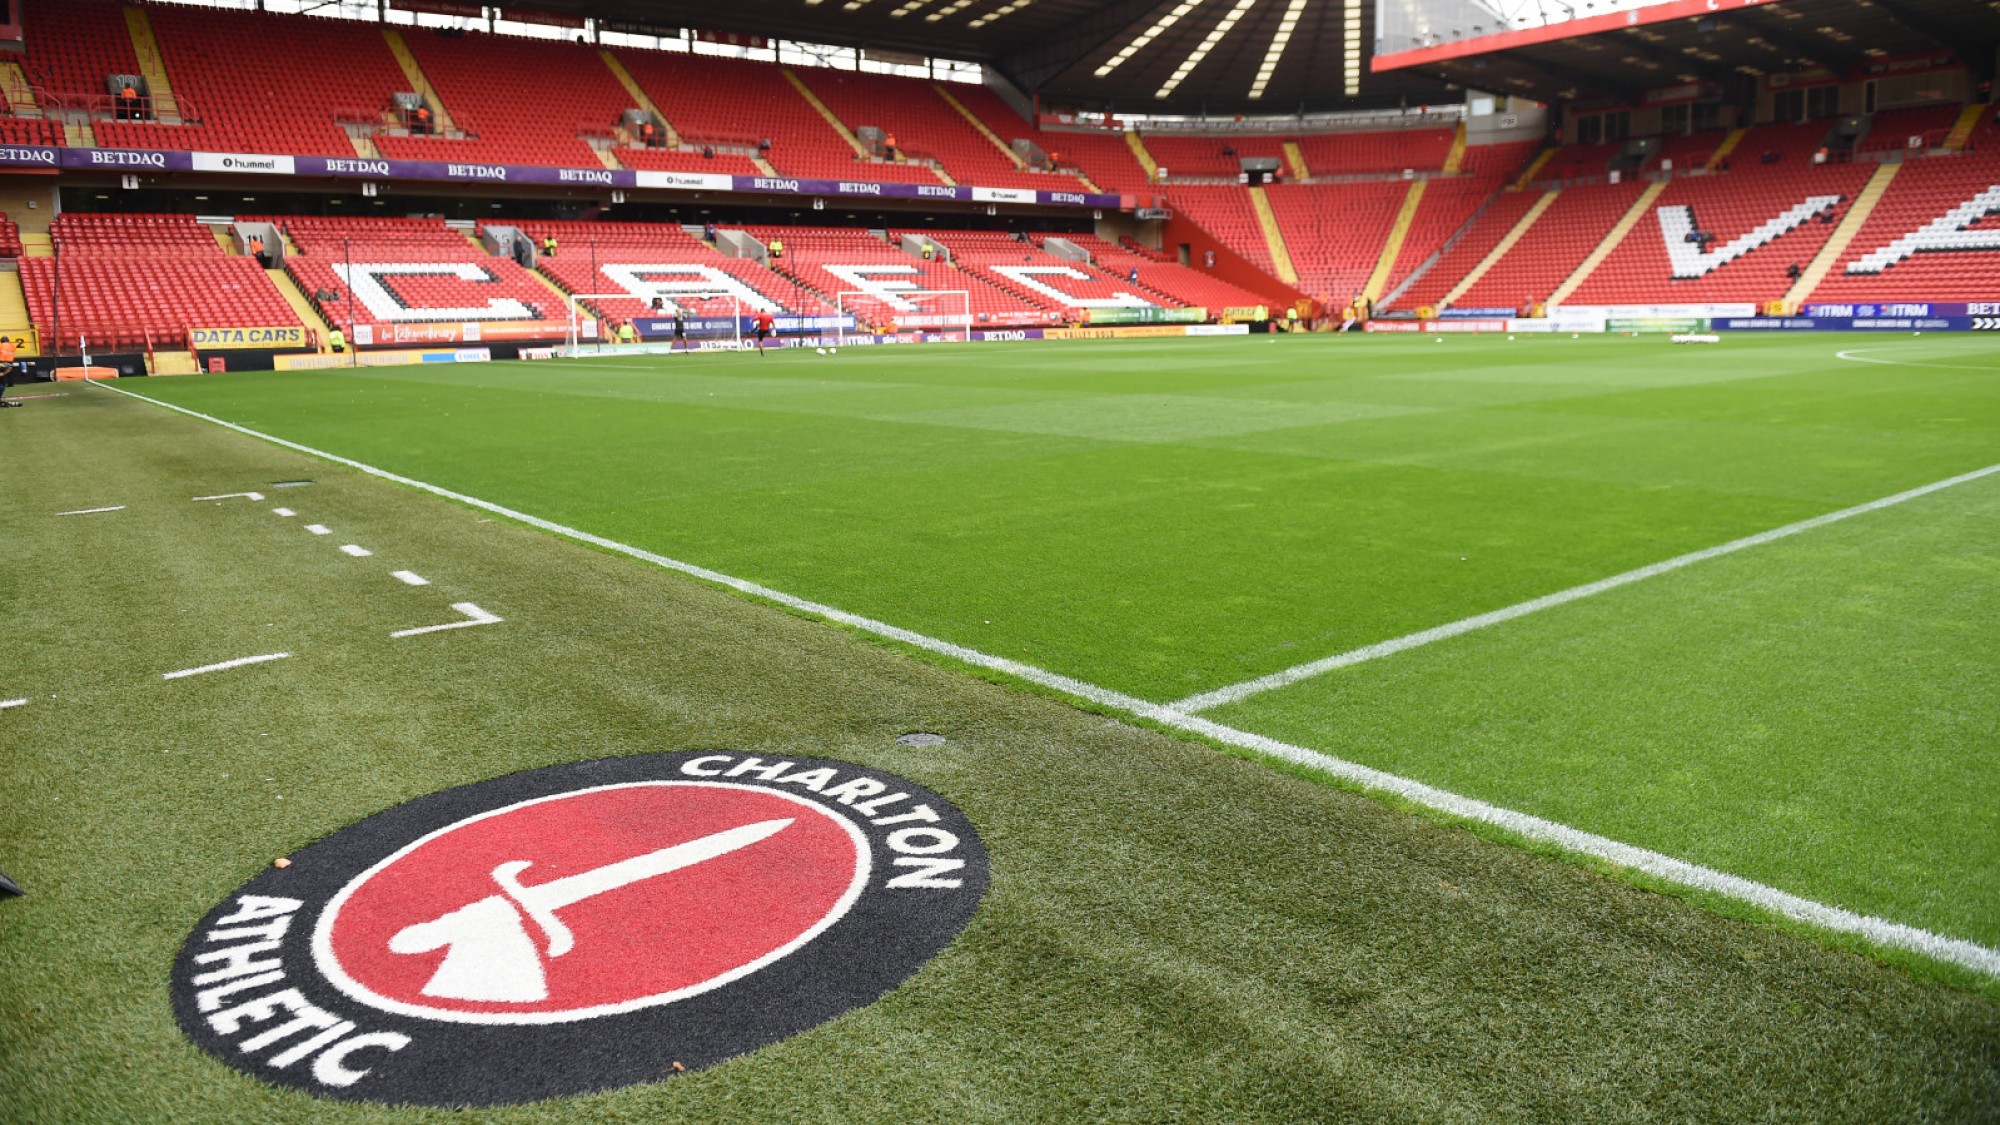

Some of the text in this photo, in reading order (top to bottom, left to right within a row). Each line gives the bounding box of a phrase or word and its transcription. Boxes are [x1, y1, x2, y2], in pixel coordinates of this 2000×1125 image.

[91, 151, 165, 167] BETDAQ
[235, 157, 275, 169] hummel
[326, 158, 389, 175] BETDAQ
[448, 164, 507, 180] BETDAQ
[559, 169, 613, 184] BETDAQ
[754, 178, 798, 192] BETDAQ
[839, 182, 881, 195] BETDAQ
[918, 185, 956, 198] BETDAQ
[1051, 192, 1085, 204] BETDAQ
[1820, 305, 1853, 317] ITRM
[1893, 304, 1928, 316] ITRM
[193, 328, 300, 343] DATA CARS
[984, 330, 1026, 341] BETDAQ
[16, 338, 25, 348] 2
[680, 752, 967, 890] CHARLTON
[192, 894, 412, 1087] ATHLETIC
